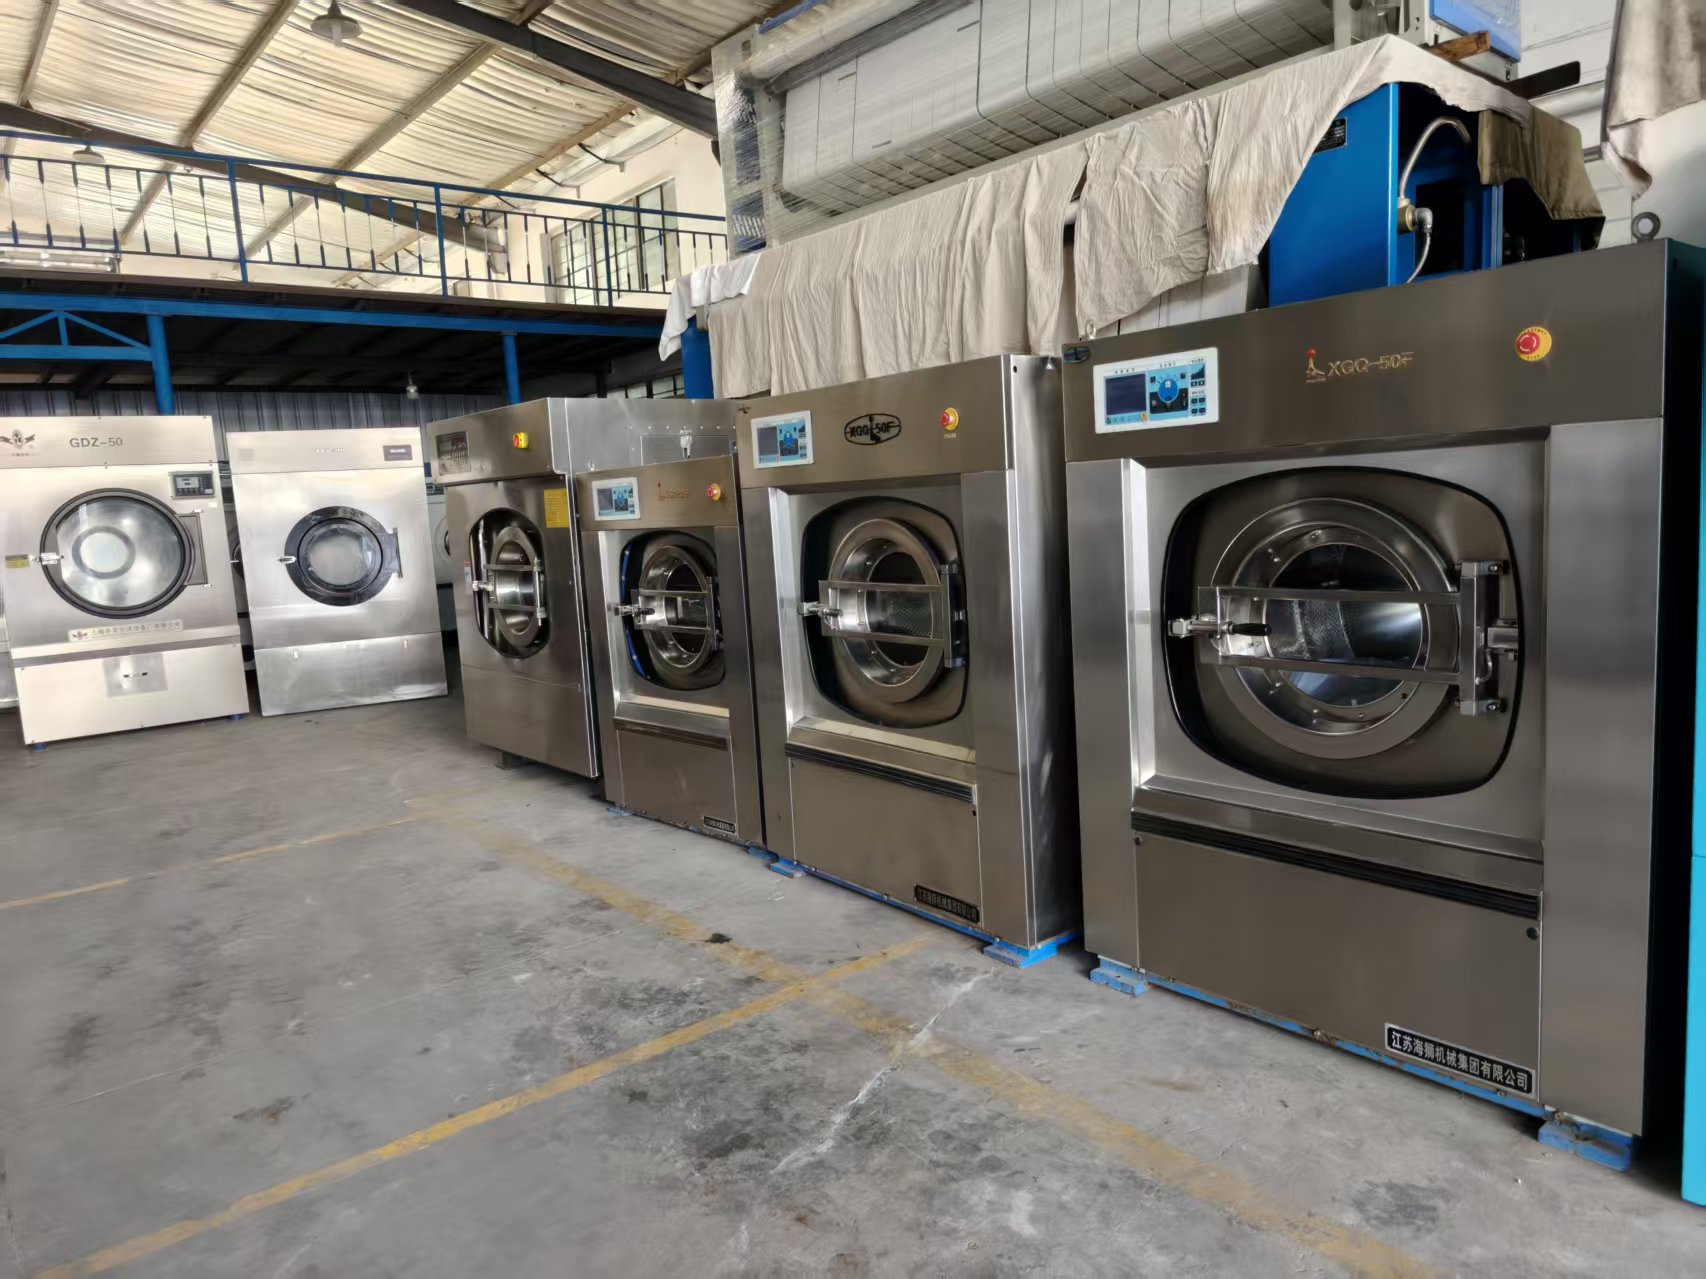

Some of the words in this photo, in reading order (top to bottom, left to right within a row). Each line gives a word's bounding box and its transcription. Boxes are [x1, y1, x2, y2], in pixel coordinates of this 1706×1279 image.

[1327, 352, 1414, 377] XGQ-50F
[69, 437, 123, 448] GDZ-50
[1391, 1031, 1528, 1091] 江苏海狮机械集团有限公司
